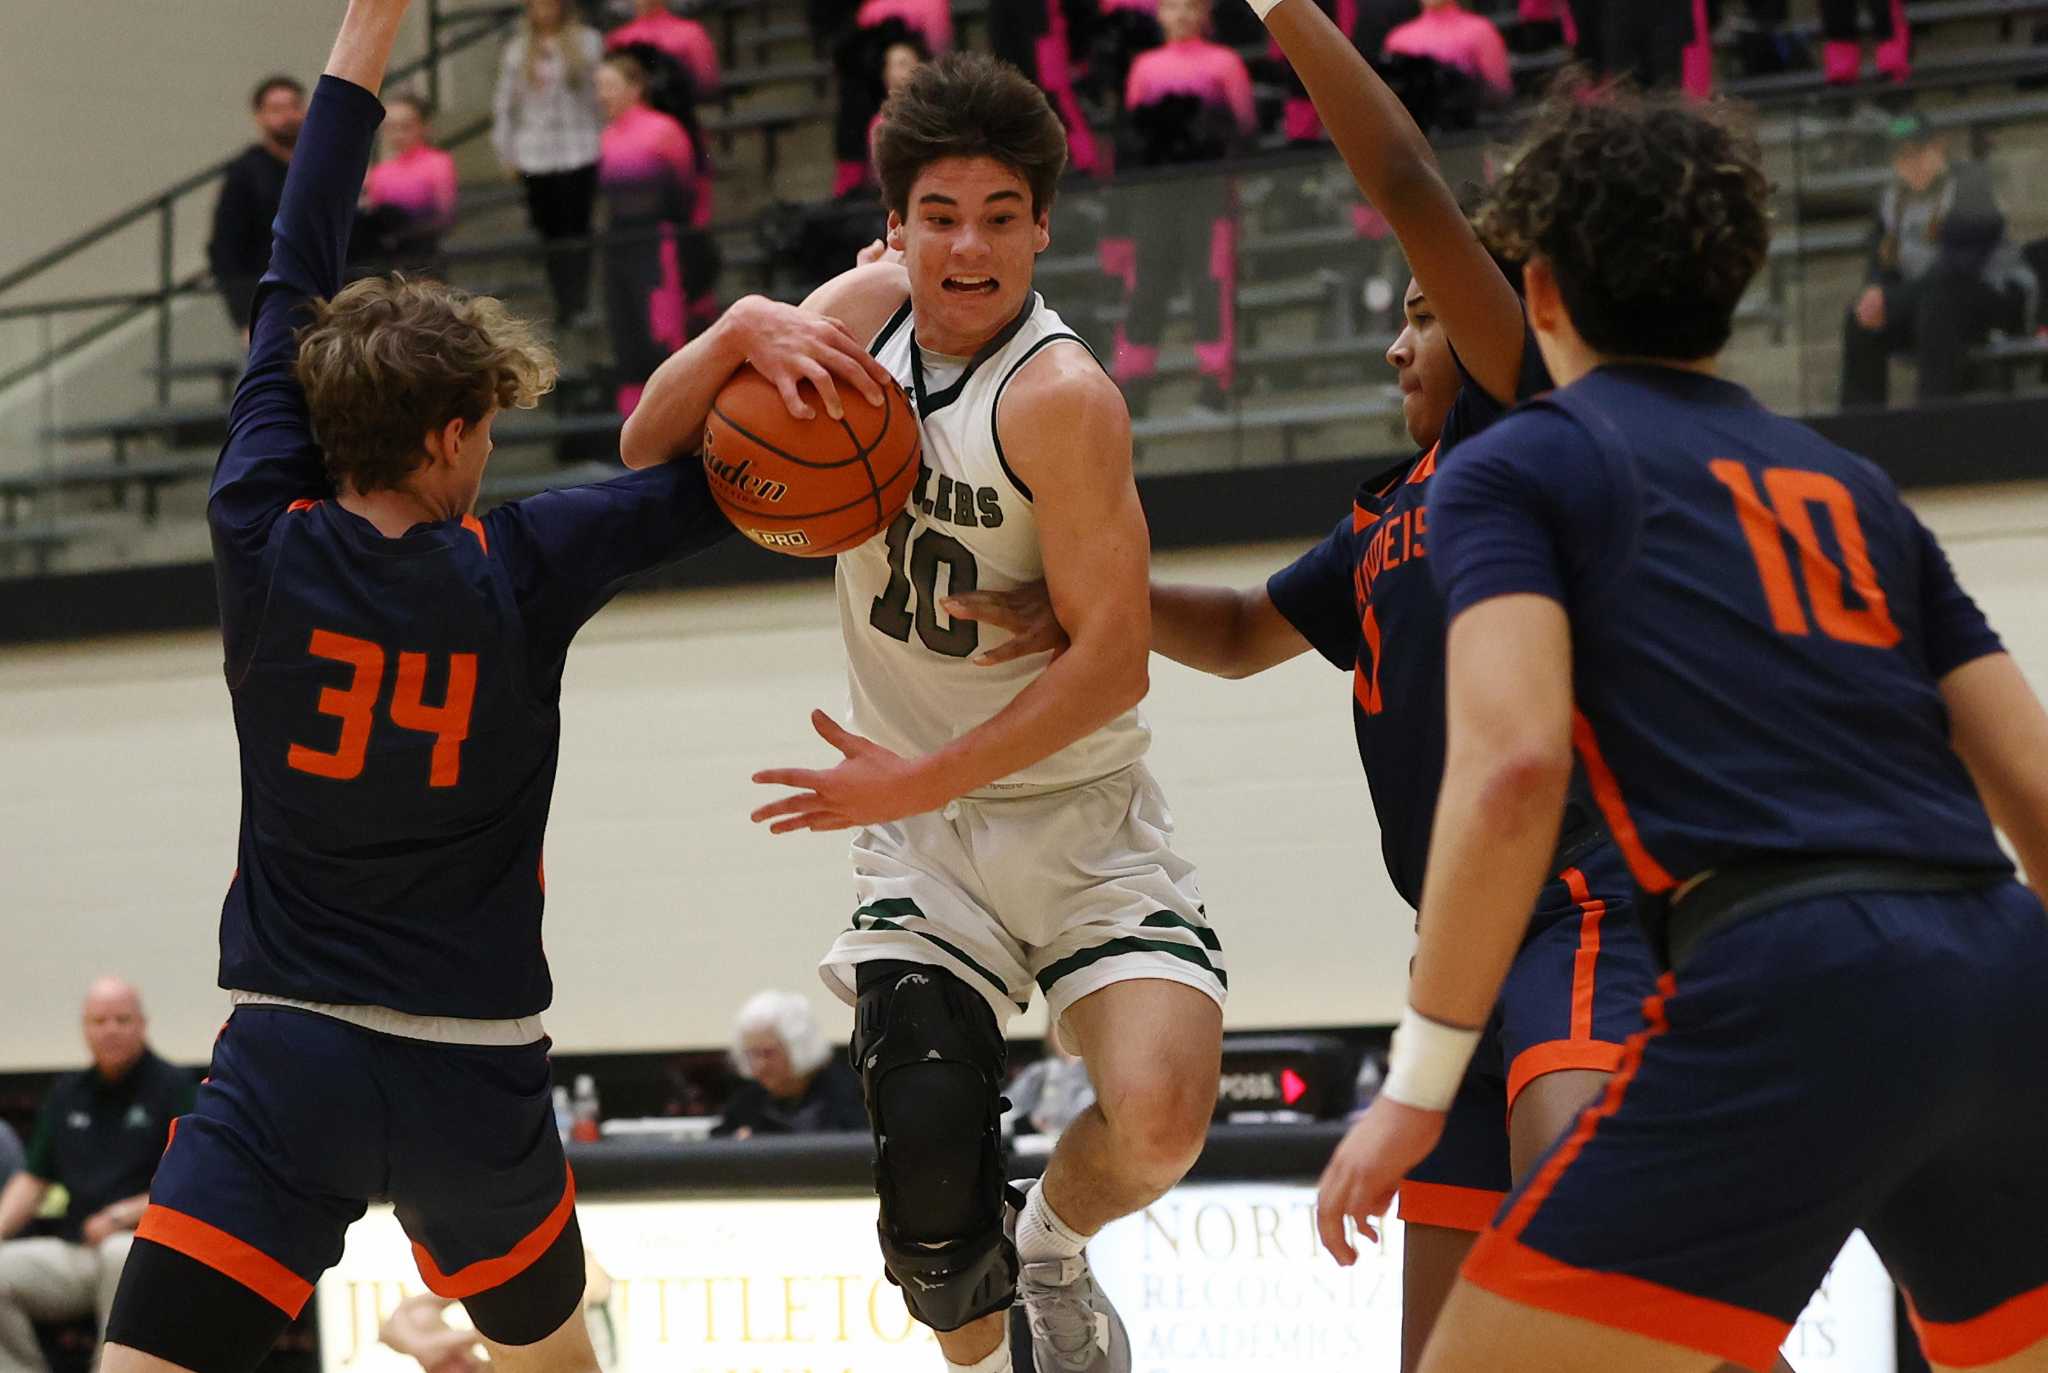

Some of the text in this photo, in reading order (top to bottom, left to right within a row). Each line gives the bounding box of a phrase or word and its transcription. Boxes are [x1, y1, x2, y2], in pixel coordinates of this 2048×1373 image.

[762, 532, 806, 547] PRO
[912, 463, 1003, 529] LERS
[869, 507, 979, 658] 10
[1707, 458, 1903, 650] 10
[287, 628, 479, 788] 34
[613, 1274, 938, 1345] ITTLETO
